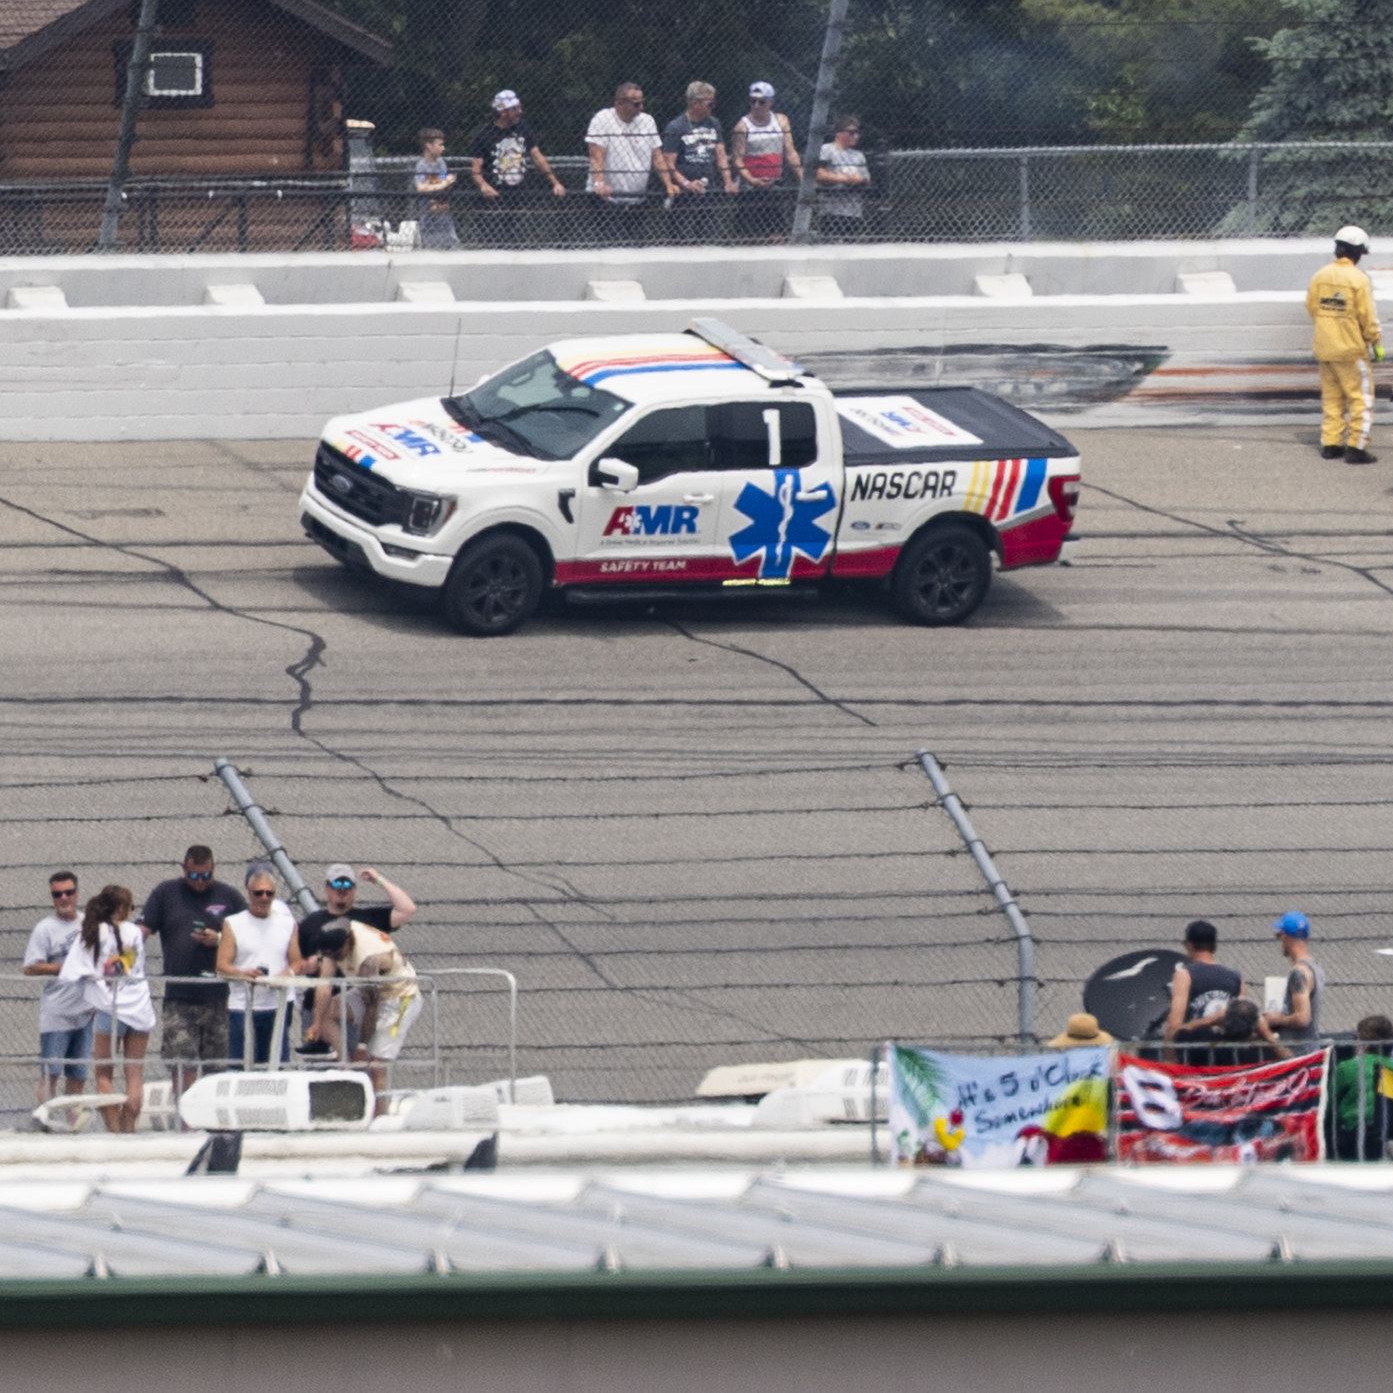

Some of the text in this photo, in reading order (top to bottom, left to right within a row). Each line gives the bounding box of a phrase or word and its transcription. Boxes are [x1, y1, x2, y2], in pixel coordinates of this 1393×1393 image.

[763, 408, 782, 466] 1
[850, 470, 958, 502] NASCAR
[602, 504, 700, 536] AMR
[600, 559, 687, 572] SAFETY TEAM
[1000, 1071, 1019, 1097] 5
[1122, 1063, 1184, 1131] 8
